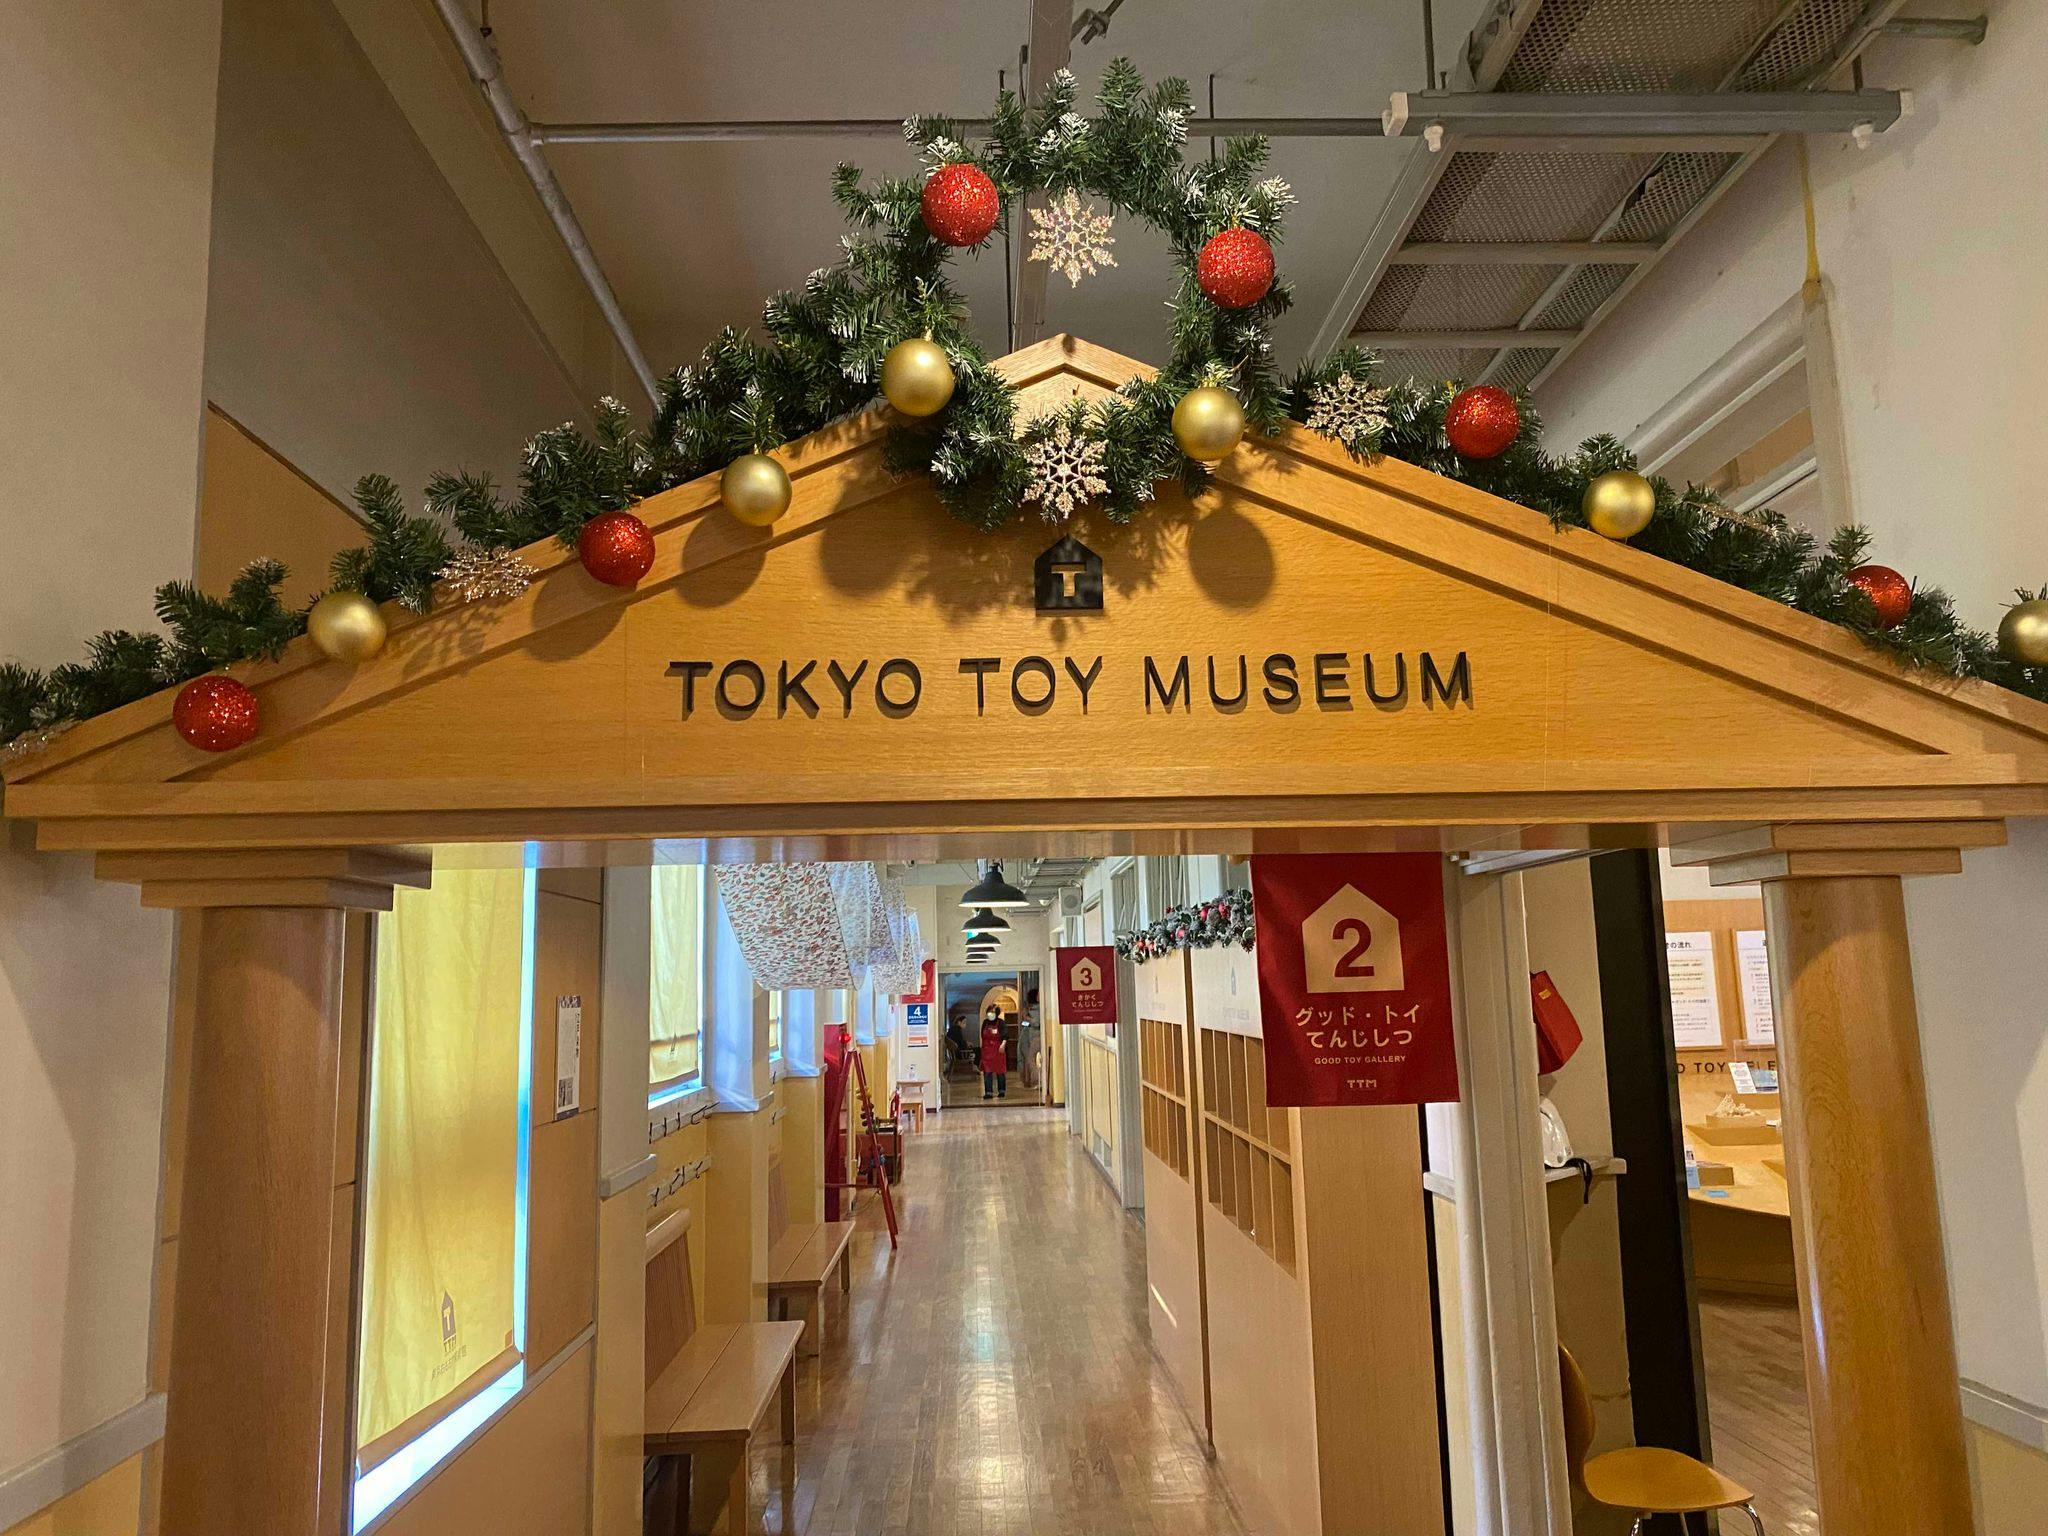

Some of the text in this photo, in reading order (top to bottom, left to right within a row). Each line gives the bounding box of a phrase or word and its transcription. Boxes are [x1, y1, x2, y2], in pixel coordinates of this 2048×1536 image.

[666, 651, 1471, 716] TOKYO TOY MUSEUM
[1331, 917, 1376, 978] 2
[1080, 967, 1093, 987] 3
[913, 1006, 921, 1016] 4
[1295, 1004, 1420, 1027] グッド・トイ
[1306, 1028, 1413, 1048] てんじしつ
[1314, 1055, 1406, 1065] GOOD TOY GALLERY
[1693, 1062, 1726, 1074] TOY
[1347, 1079, 1377, 1088] TTM
